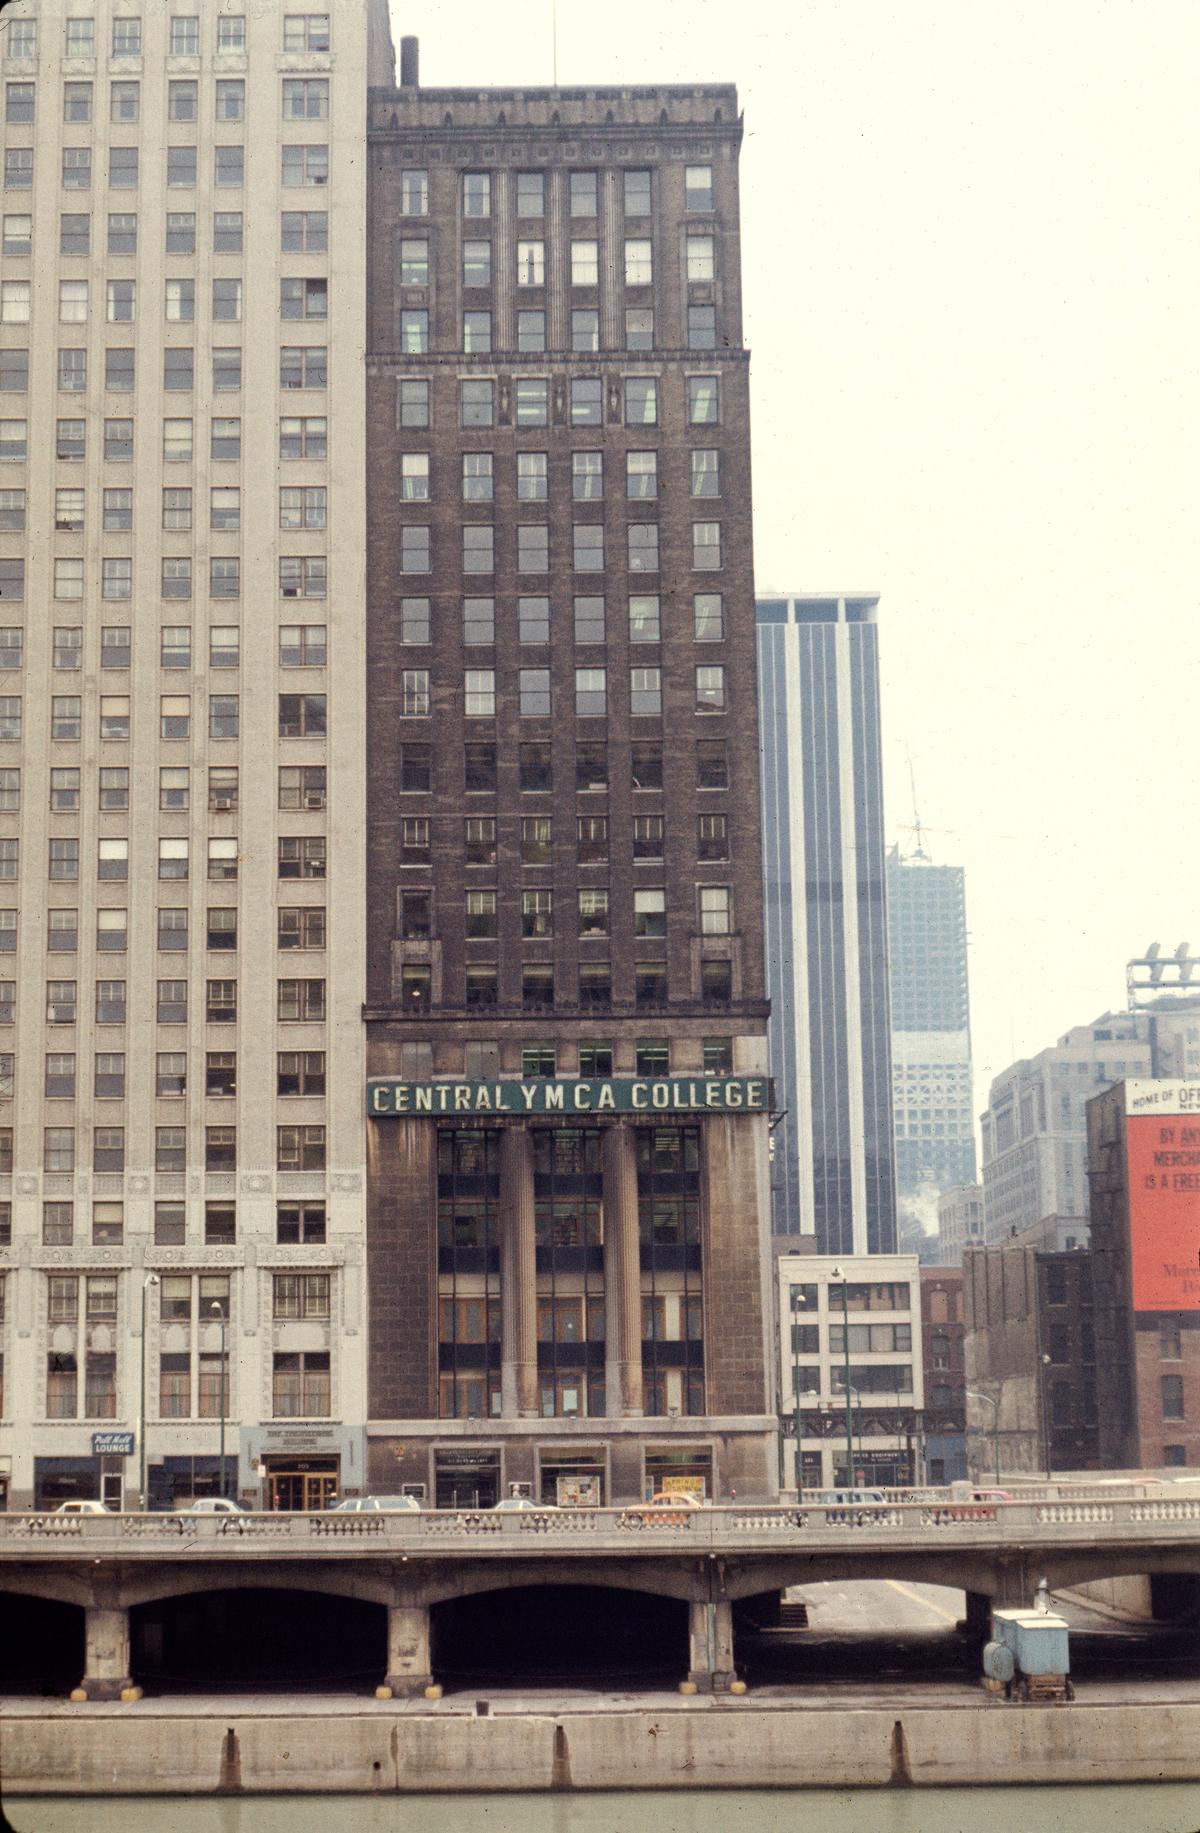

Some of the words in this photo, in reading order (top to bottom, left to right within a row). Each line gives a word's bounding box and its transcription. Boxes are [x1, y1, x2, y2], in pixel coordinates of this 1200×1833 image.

[373, 1085, 511, 1111] CENTRAL
[520, 1083, 616, 1110] YMCA
[631, 1082, 763, 1108] COLLEGE
[1133, 1093, 1159, 1108] HOME
[1162, 1089, 1174, 1101] OF
[1160, 1127, 1175, 1144] BY
[1161, 1174, 1168, 1189] A
[96, 1444, 129, 1453] LOUNGE
